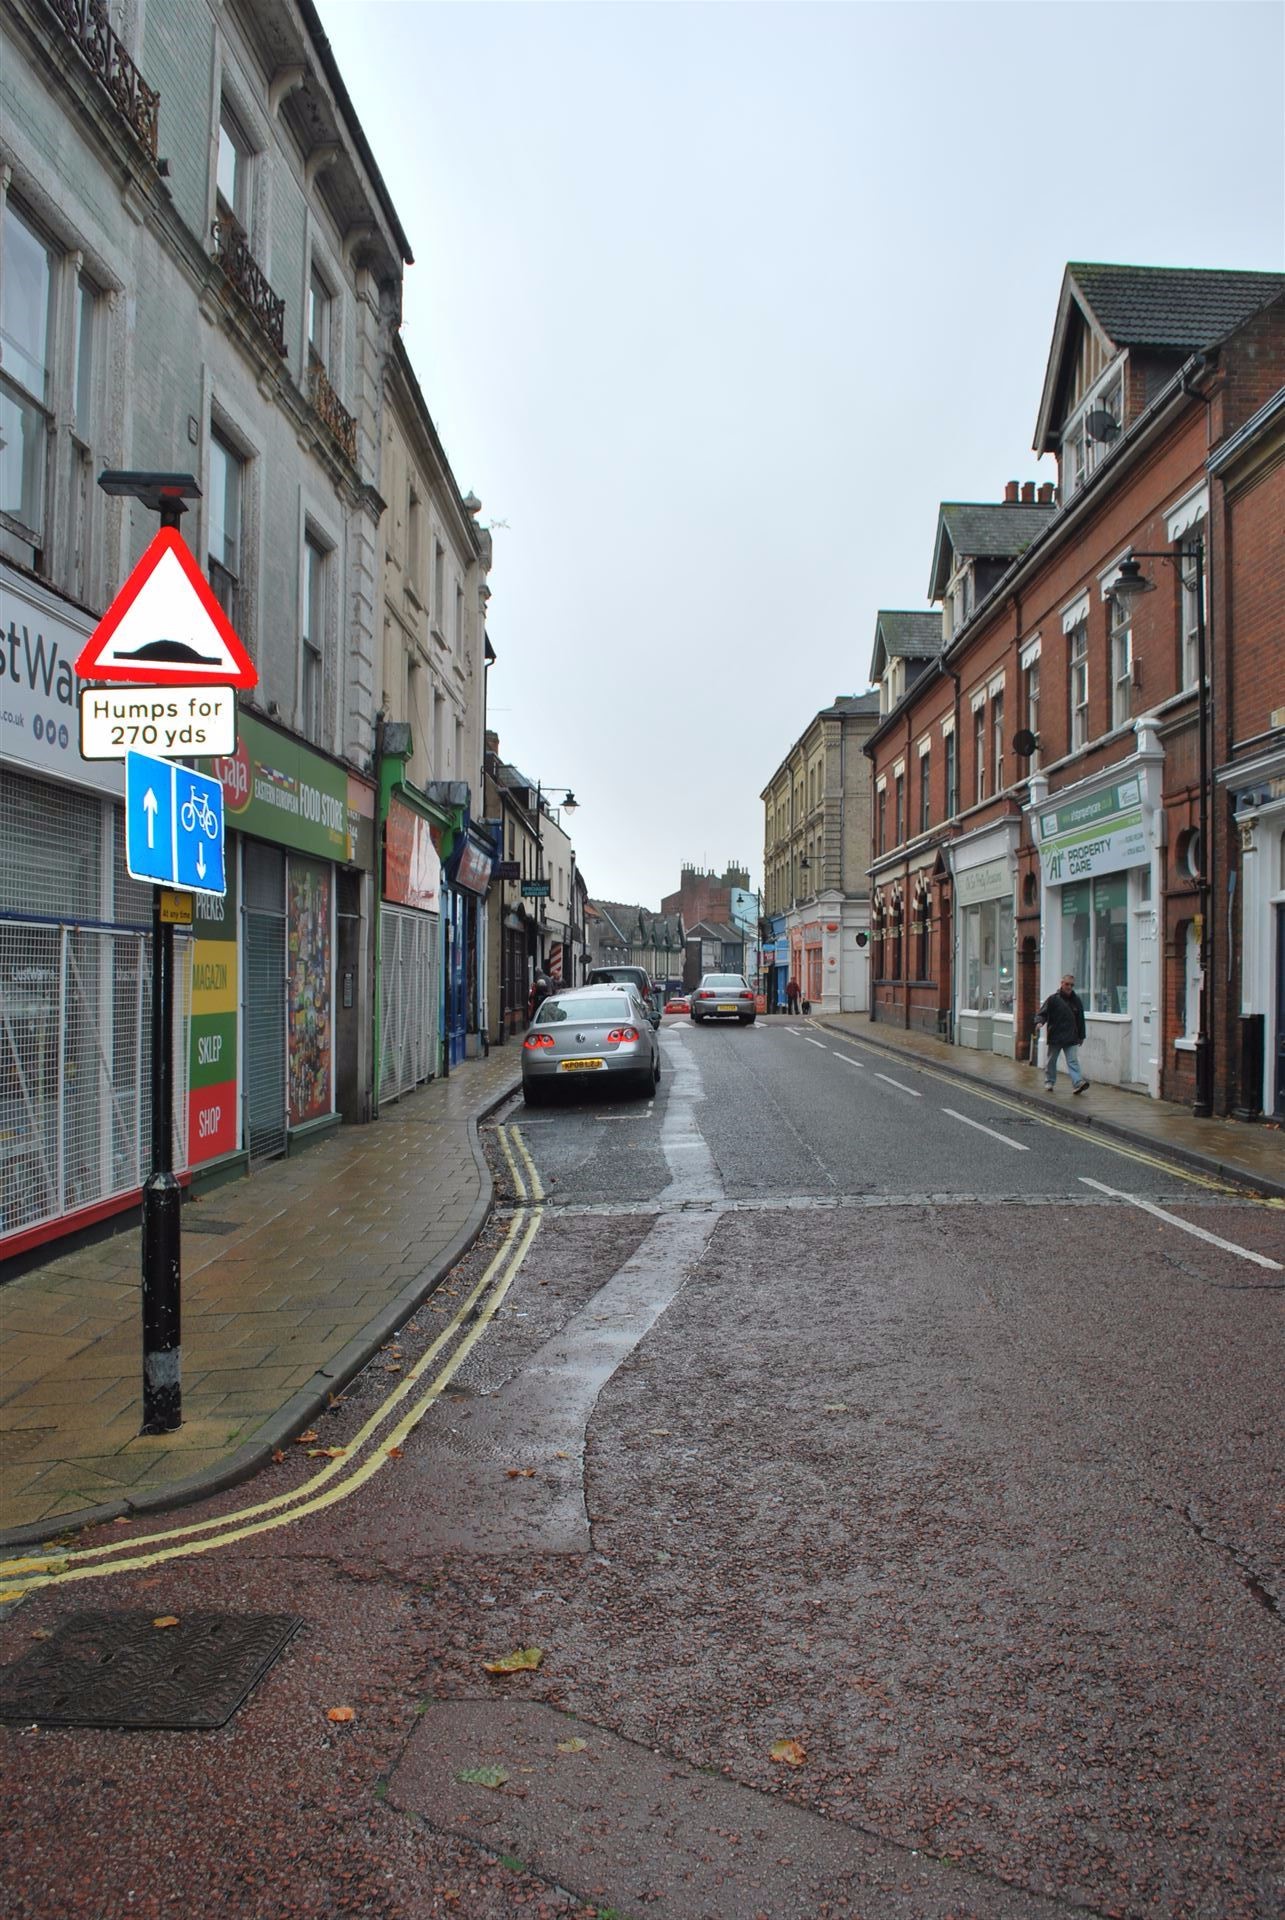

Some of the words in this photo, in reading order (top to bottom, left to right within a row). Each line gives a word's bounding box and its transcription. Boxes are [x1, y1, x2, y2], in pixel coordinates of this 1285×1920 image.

[94, 700, 178, 721] Humps
[188, 698, 222, 717] for
[111, 725, 157, 745] 270
[165, 725, 206, 748] yds
[254, 778, 276, 806] EASTERN
[276, 787, 299, 815] EUROPEAN
[299, 782, 321, 822] FOOD
[321, 792, 344, 833] STORE
[1067, 838, 1111, 862] PROPERTY
[1069, 859, 1092, 875] CARE
[163, 910, 169, 918] At
[180, 910, 190, 918] time
[192, 964, 227, 991] MAGAZIN
[198, 1035, 222, 1065] SKLEP
[198, 1106, 221, 1138] SHOP
